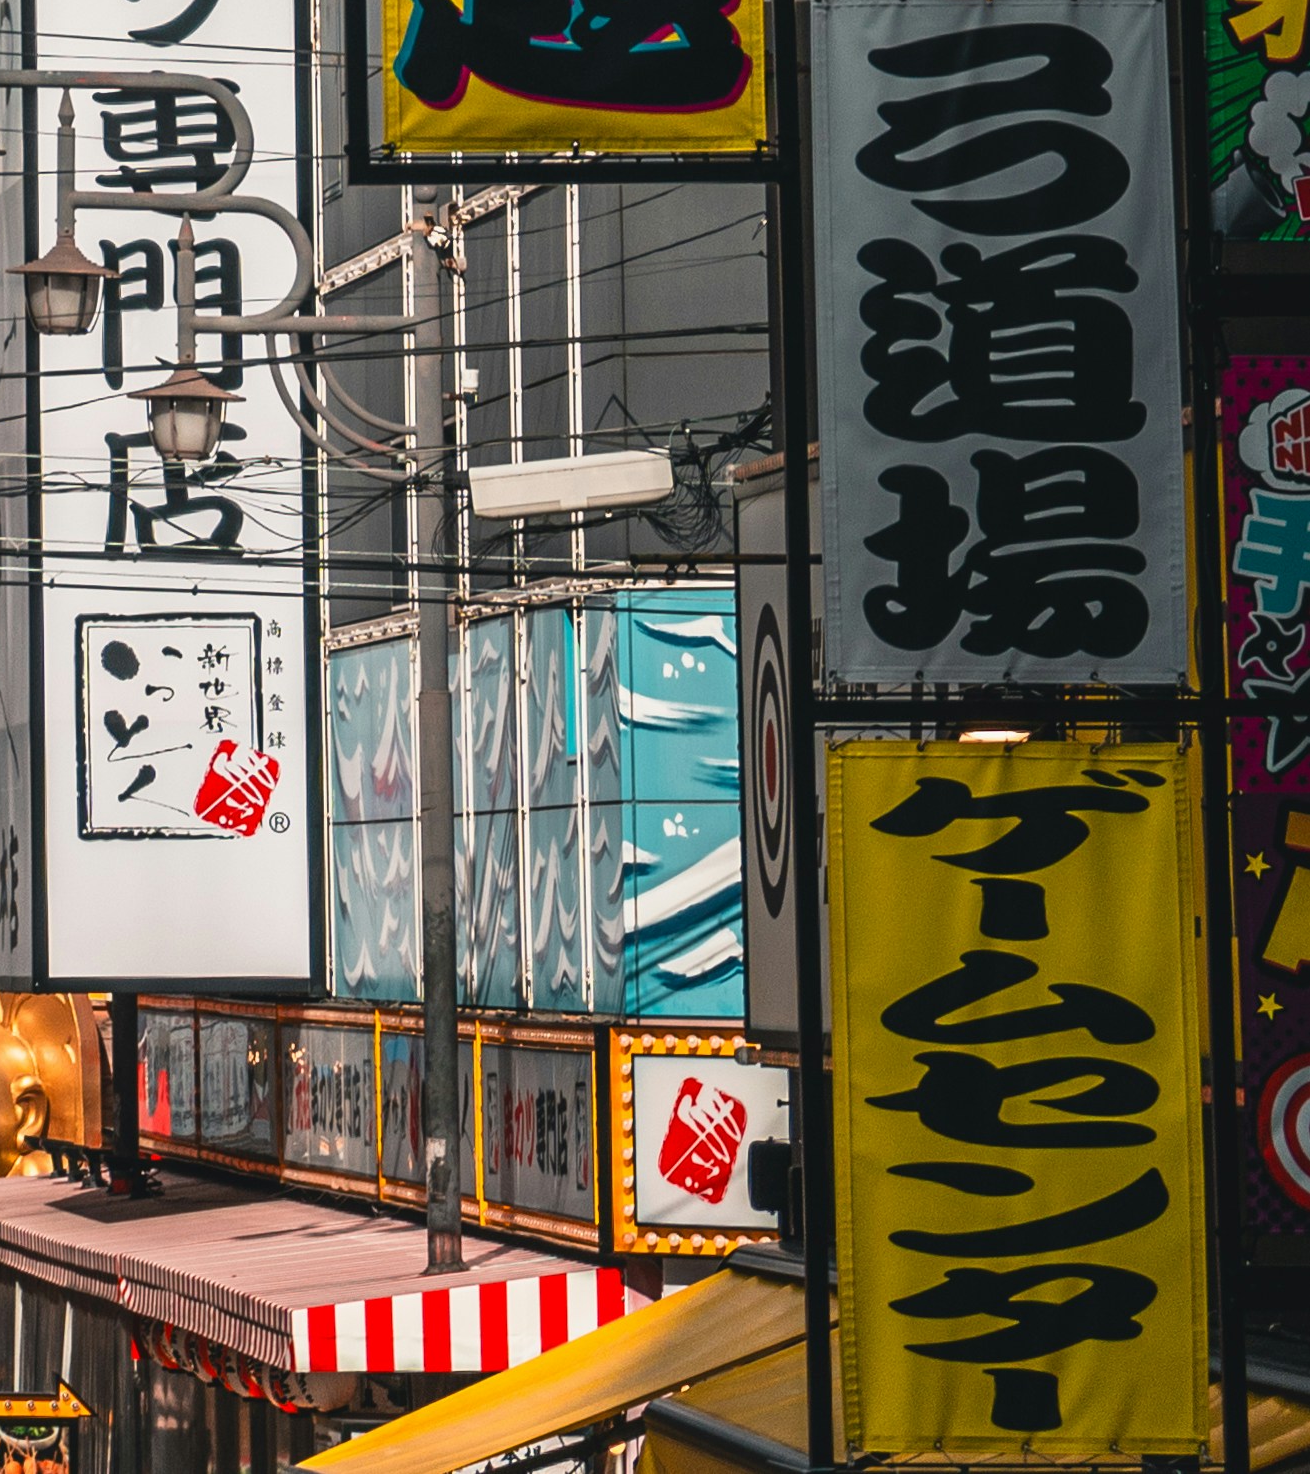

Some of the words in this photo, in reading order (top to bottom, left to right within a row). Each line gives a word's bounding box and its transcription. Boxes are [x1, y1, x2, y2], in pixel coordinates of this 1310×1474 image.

[865, 768, 1170, 1432] ゲームセンター
